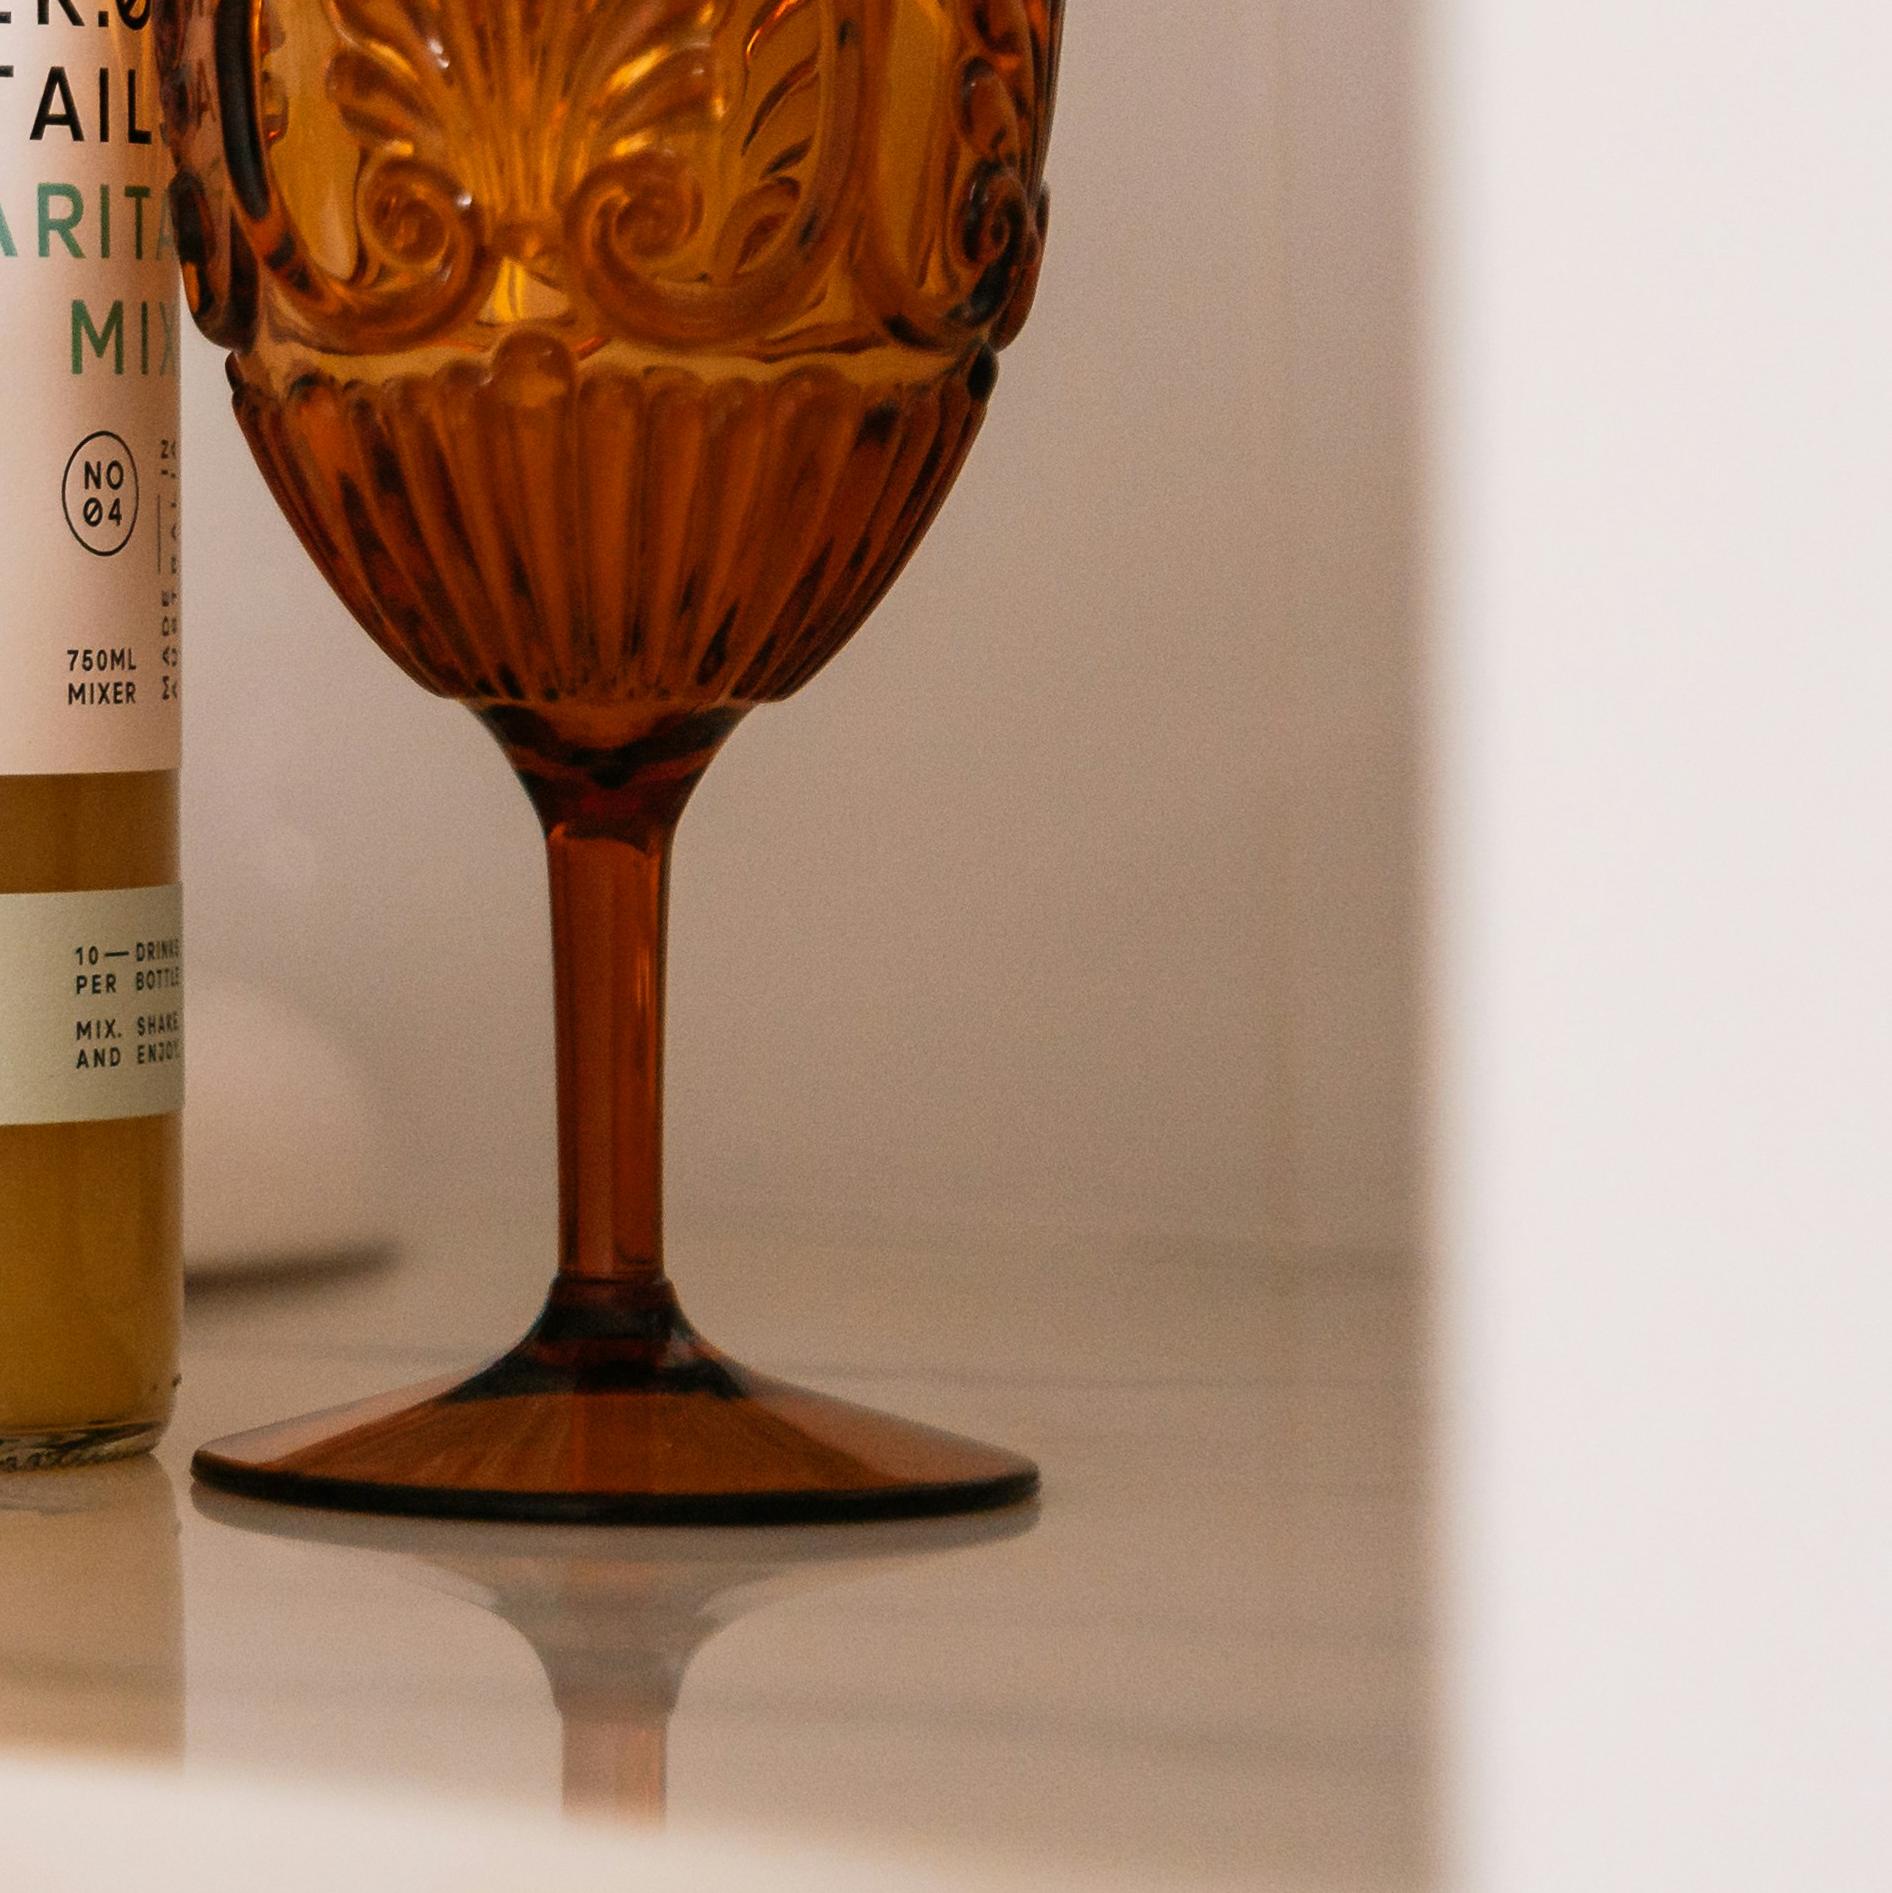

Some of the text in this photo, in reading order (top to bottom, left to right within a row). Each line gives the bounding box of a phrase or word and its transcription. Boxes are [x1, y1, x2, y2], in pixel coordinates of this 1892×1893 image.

[84, 460, 124, 490] NO
[83, 497, 122, 527] 04
[67, 648, 136, 671] 750ML
[68, 681, 136, 705] MIXER
[76, 973, 116, 994] PER
[76, 1047, 121, 1069] AND
